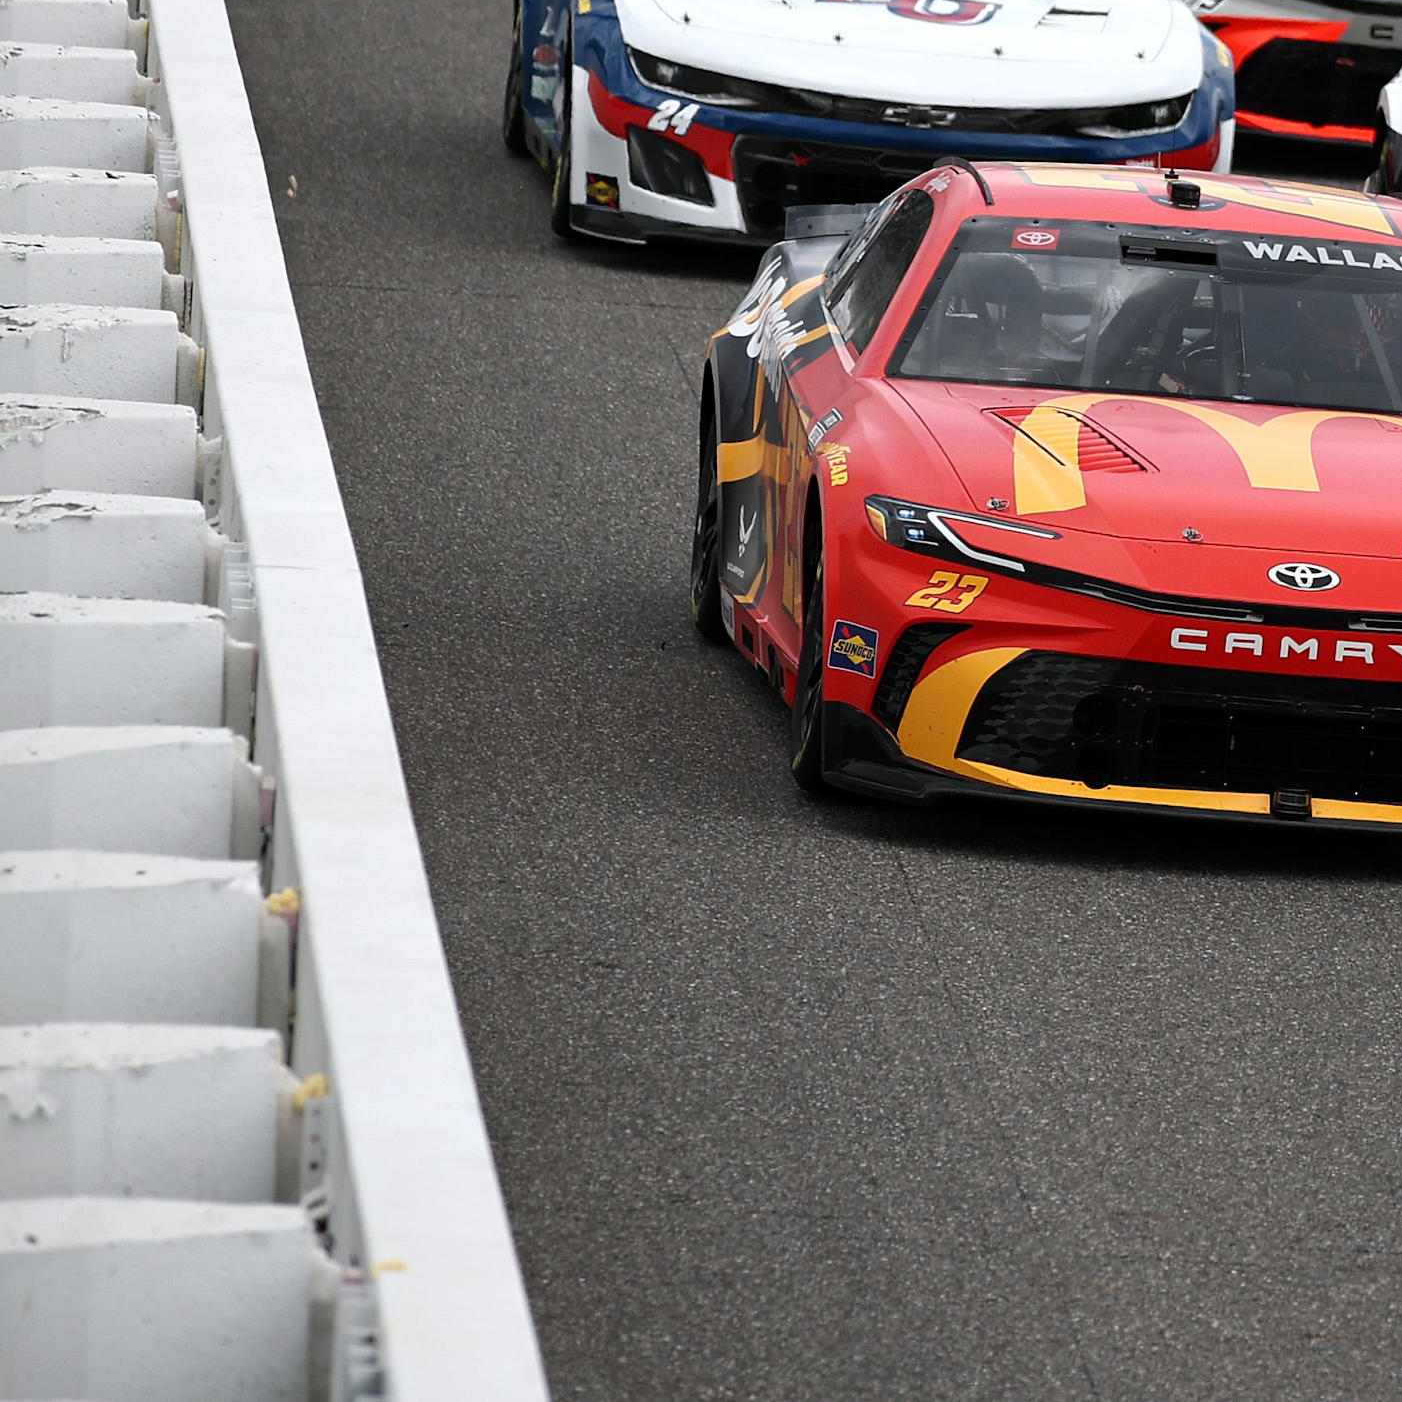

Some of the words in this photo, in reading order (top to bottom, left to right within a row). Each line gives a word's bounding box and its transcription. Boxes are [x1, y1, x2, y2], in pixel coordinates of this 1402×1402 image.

[646, 98, 701, 136] 24
[904, 569, 991, 614] 23
[834, 638, 876, 662] SUNOCO
